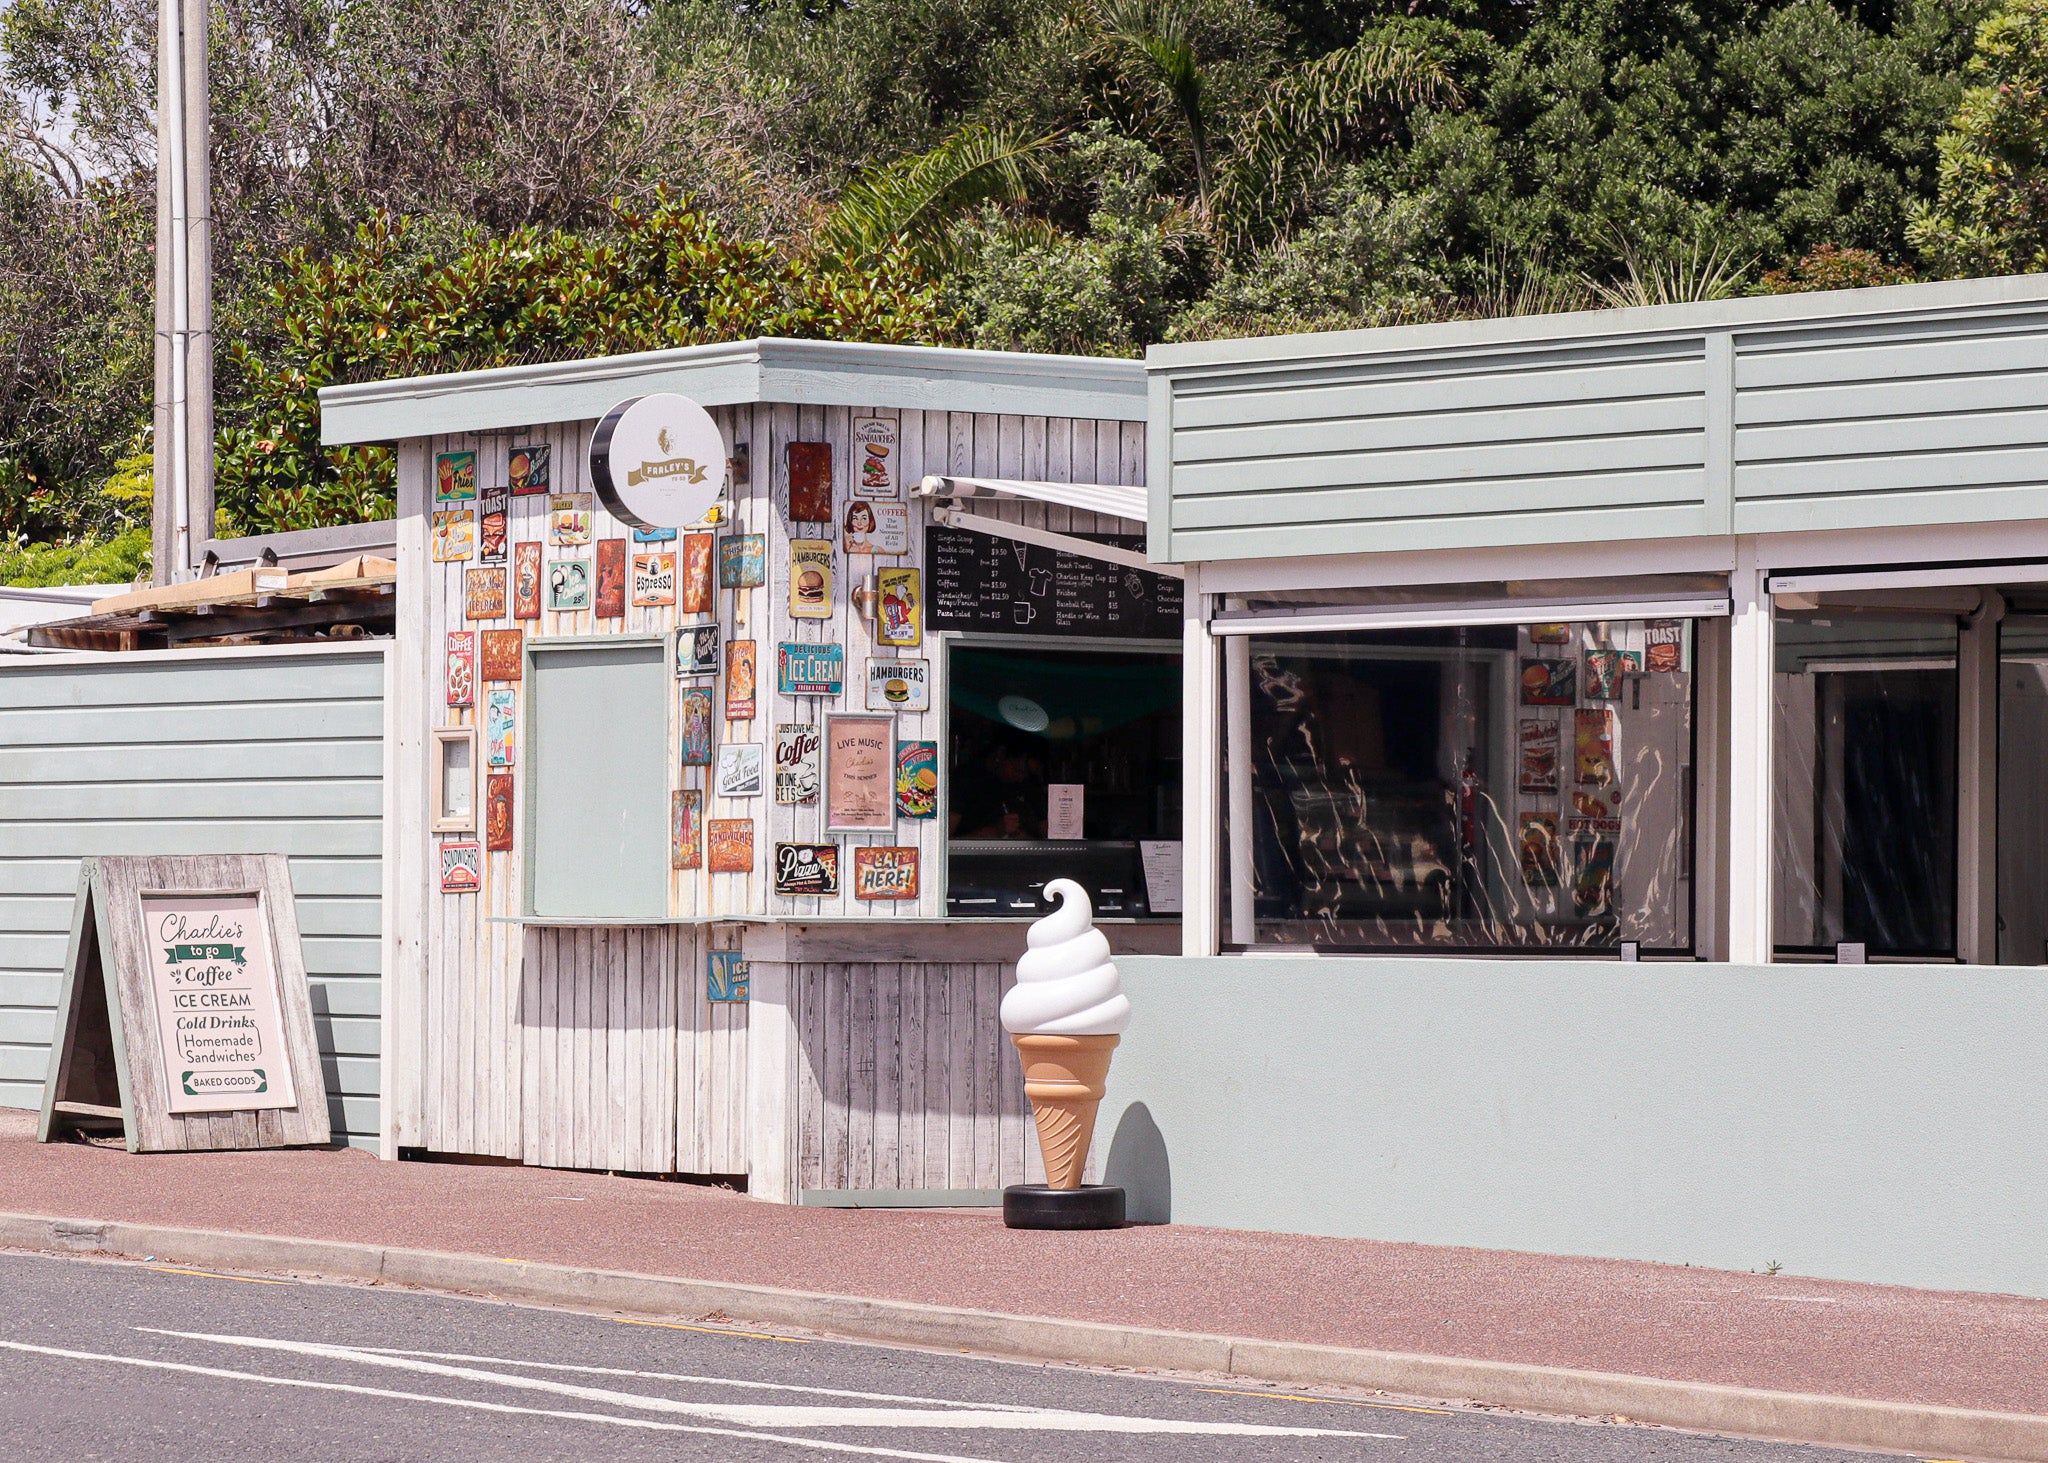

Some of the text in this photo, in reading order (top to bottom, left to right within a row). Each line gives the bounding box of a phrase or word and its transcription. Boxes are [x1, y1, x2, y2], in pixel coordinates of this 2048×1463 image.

[856, 432, 896, 444] SANDWICHES
[453, 470, 474, 490] Fries
[480, 494, 506, 516] TOAST
[793, 552, 831, 570] HAMBURGERS
[636, 574, 672, 594] espresso
[1095, 574, 1106, 582] Cup
[448, 636, 473, 652] COFFEE
[1644, 626, 1680, 645] TOAST
[794, 645, 831, 654] DELICIOUS
[788, 654, 842, 683] ICE CREAM
[870, 666, 924, 683] HAMBURGERS
[778, 724, 814, 734] JUST GIVE ME
[776, 734, 819, 766] Coffee
[836, 738, 856, 750] LIVE
[858, 738, 884, 750] MUSIC
[722, 770, 741, 788] Good
[742, 762, 760, 779] Food
[776, 773, 797, 786] NO ONE
[776, 788, 796, 801] GETS
[1568, 820, 1620, 830] HOT DOGS
[710, 830, 753, 847] SANDWICHES
[444, 848, 478, 876] SANDWICHES
[776, 846, 820, 883] Pizza
[874, 850, 903, 869] EAT
[864, 868, 912, 888] HERE!
[160, 913, 244, 943] Charlie's
[190, 944, 220, 960] to go
[184, 966, 232, 986] Coffee
[174, 993, 251, 1008] ICE CREAM
[176, 1016, 256, 1031] Cold Drinks
[184, 1032, 254, 1048] Homemade
[186, 1048, 256, 1064] Sandwiches
[194, 1076, 256, 1088] BAKED GOODS
